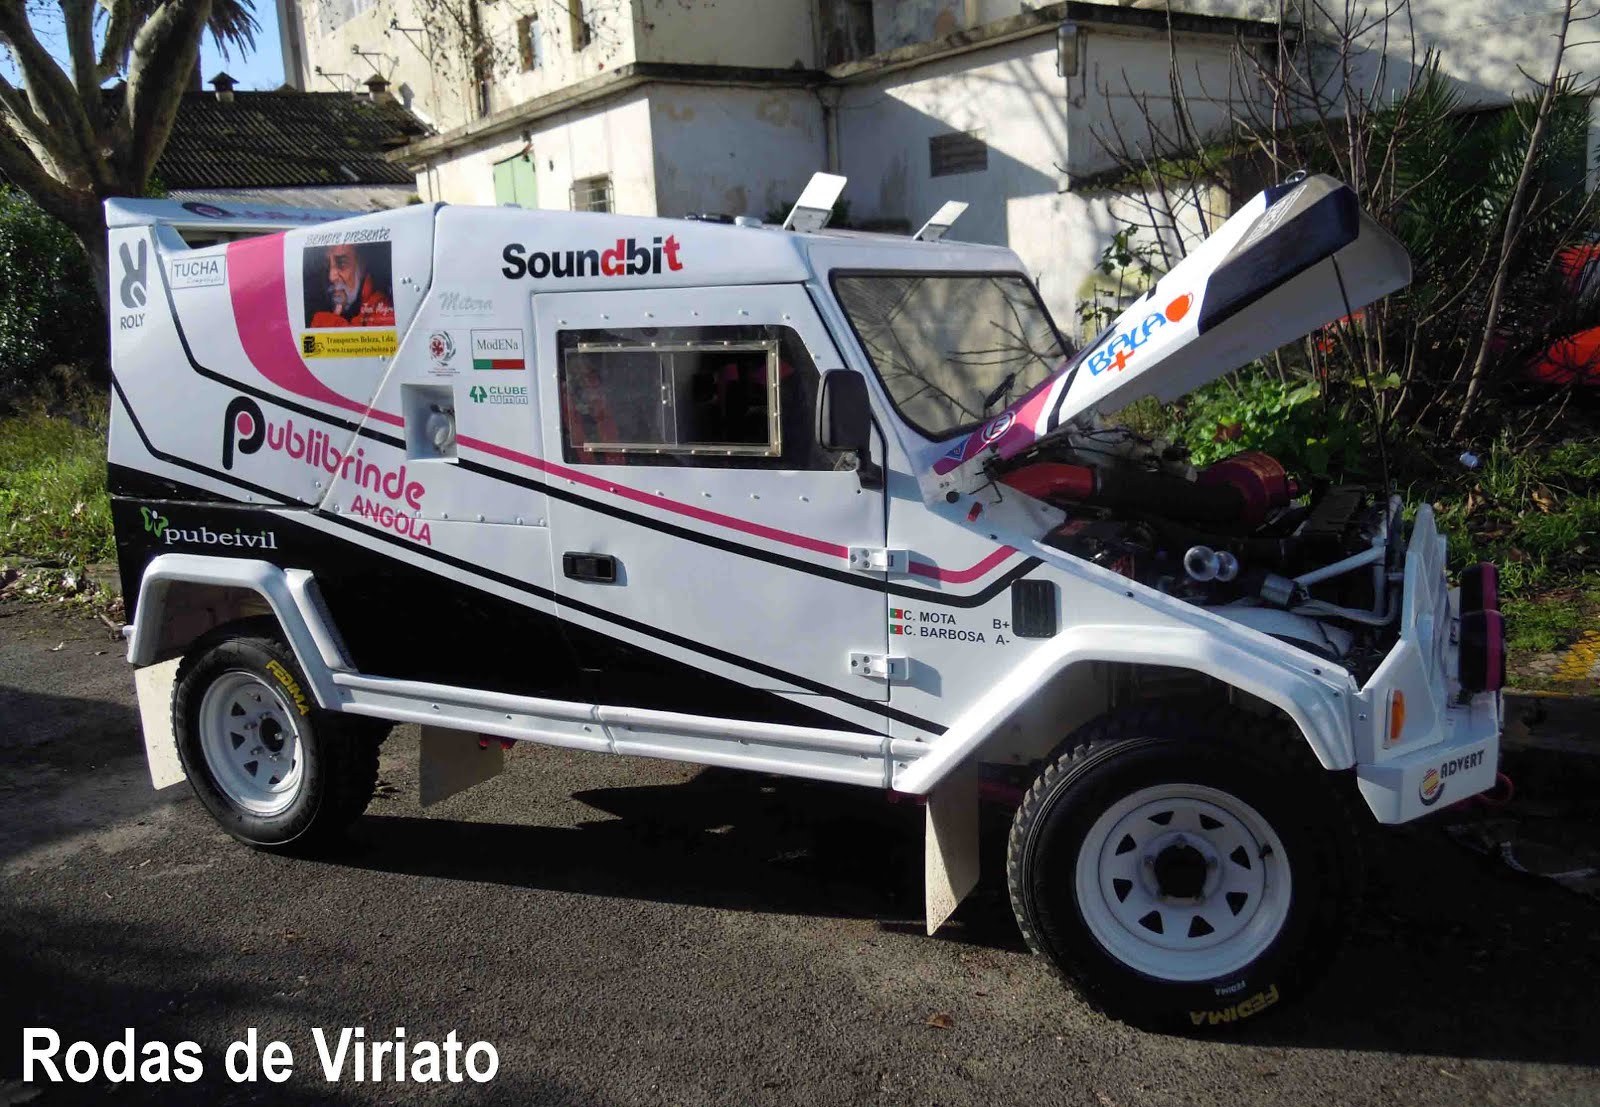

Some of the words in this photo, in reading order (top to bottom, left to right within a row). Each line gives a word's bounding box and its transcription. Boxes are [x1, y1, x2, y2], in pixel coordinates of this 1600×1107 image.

[343, 227, 391, 245] presente
[502, 234, 683, 280] Soundbit
[174, 260, 219, 278] TUCHA
[120, 313, 146, 330] ROLY
[477, 339, 519, 351] ModENa
[489, 386, 528, 395] CLUBE
[222, 396, 426, 510] Publibrinde
[350, 494, 432, 546] ANGOLA
[164, 527, 278, 550] pubeivil
[903, 610, 916, 622] C.
[920, 611, 957, 625] MOTA
[993, 618, 1010, 630] B+
[903, 625, 917, 636] C.
[920, 627, 985, 643] BARBOSA
[995, 634, 1010, 646] A-
[265, 659, 310, 716] FEDIMA
[1440, 750, 1485, 779] ADVERT
[1190, 983, 1280, 1025] FEDIMA
